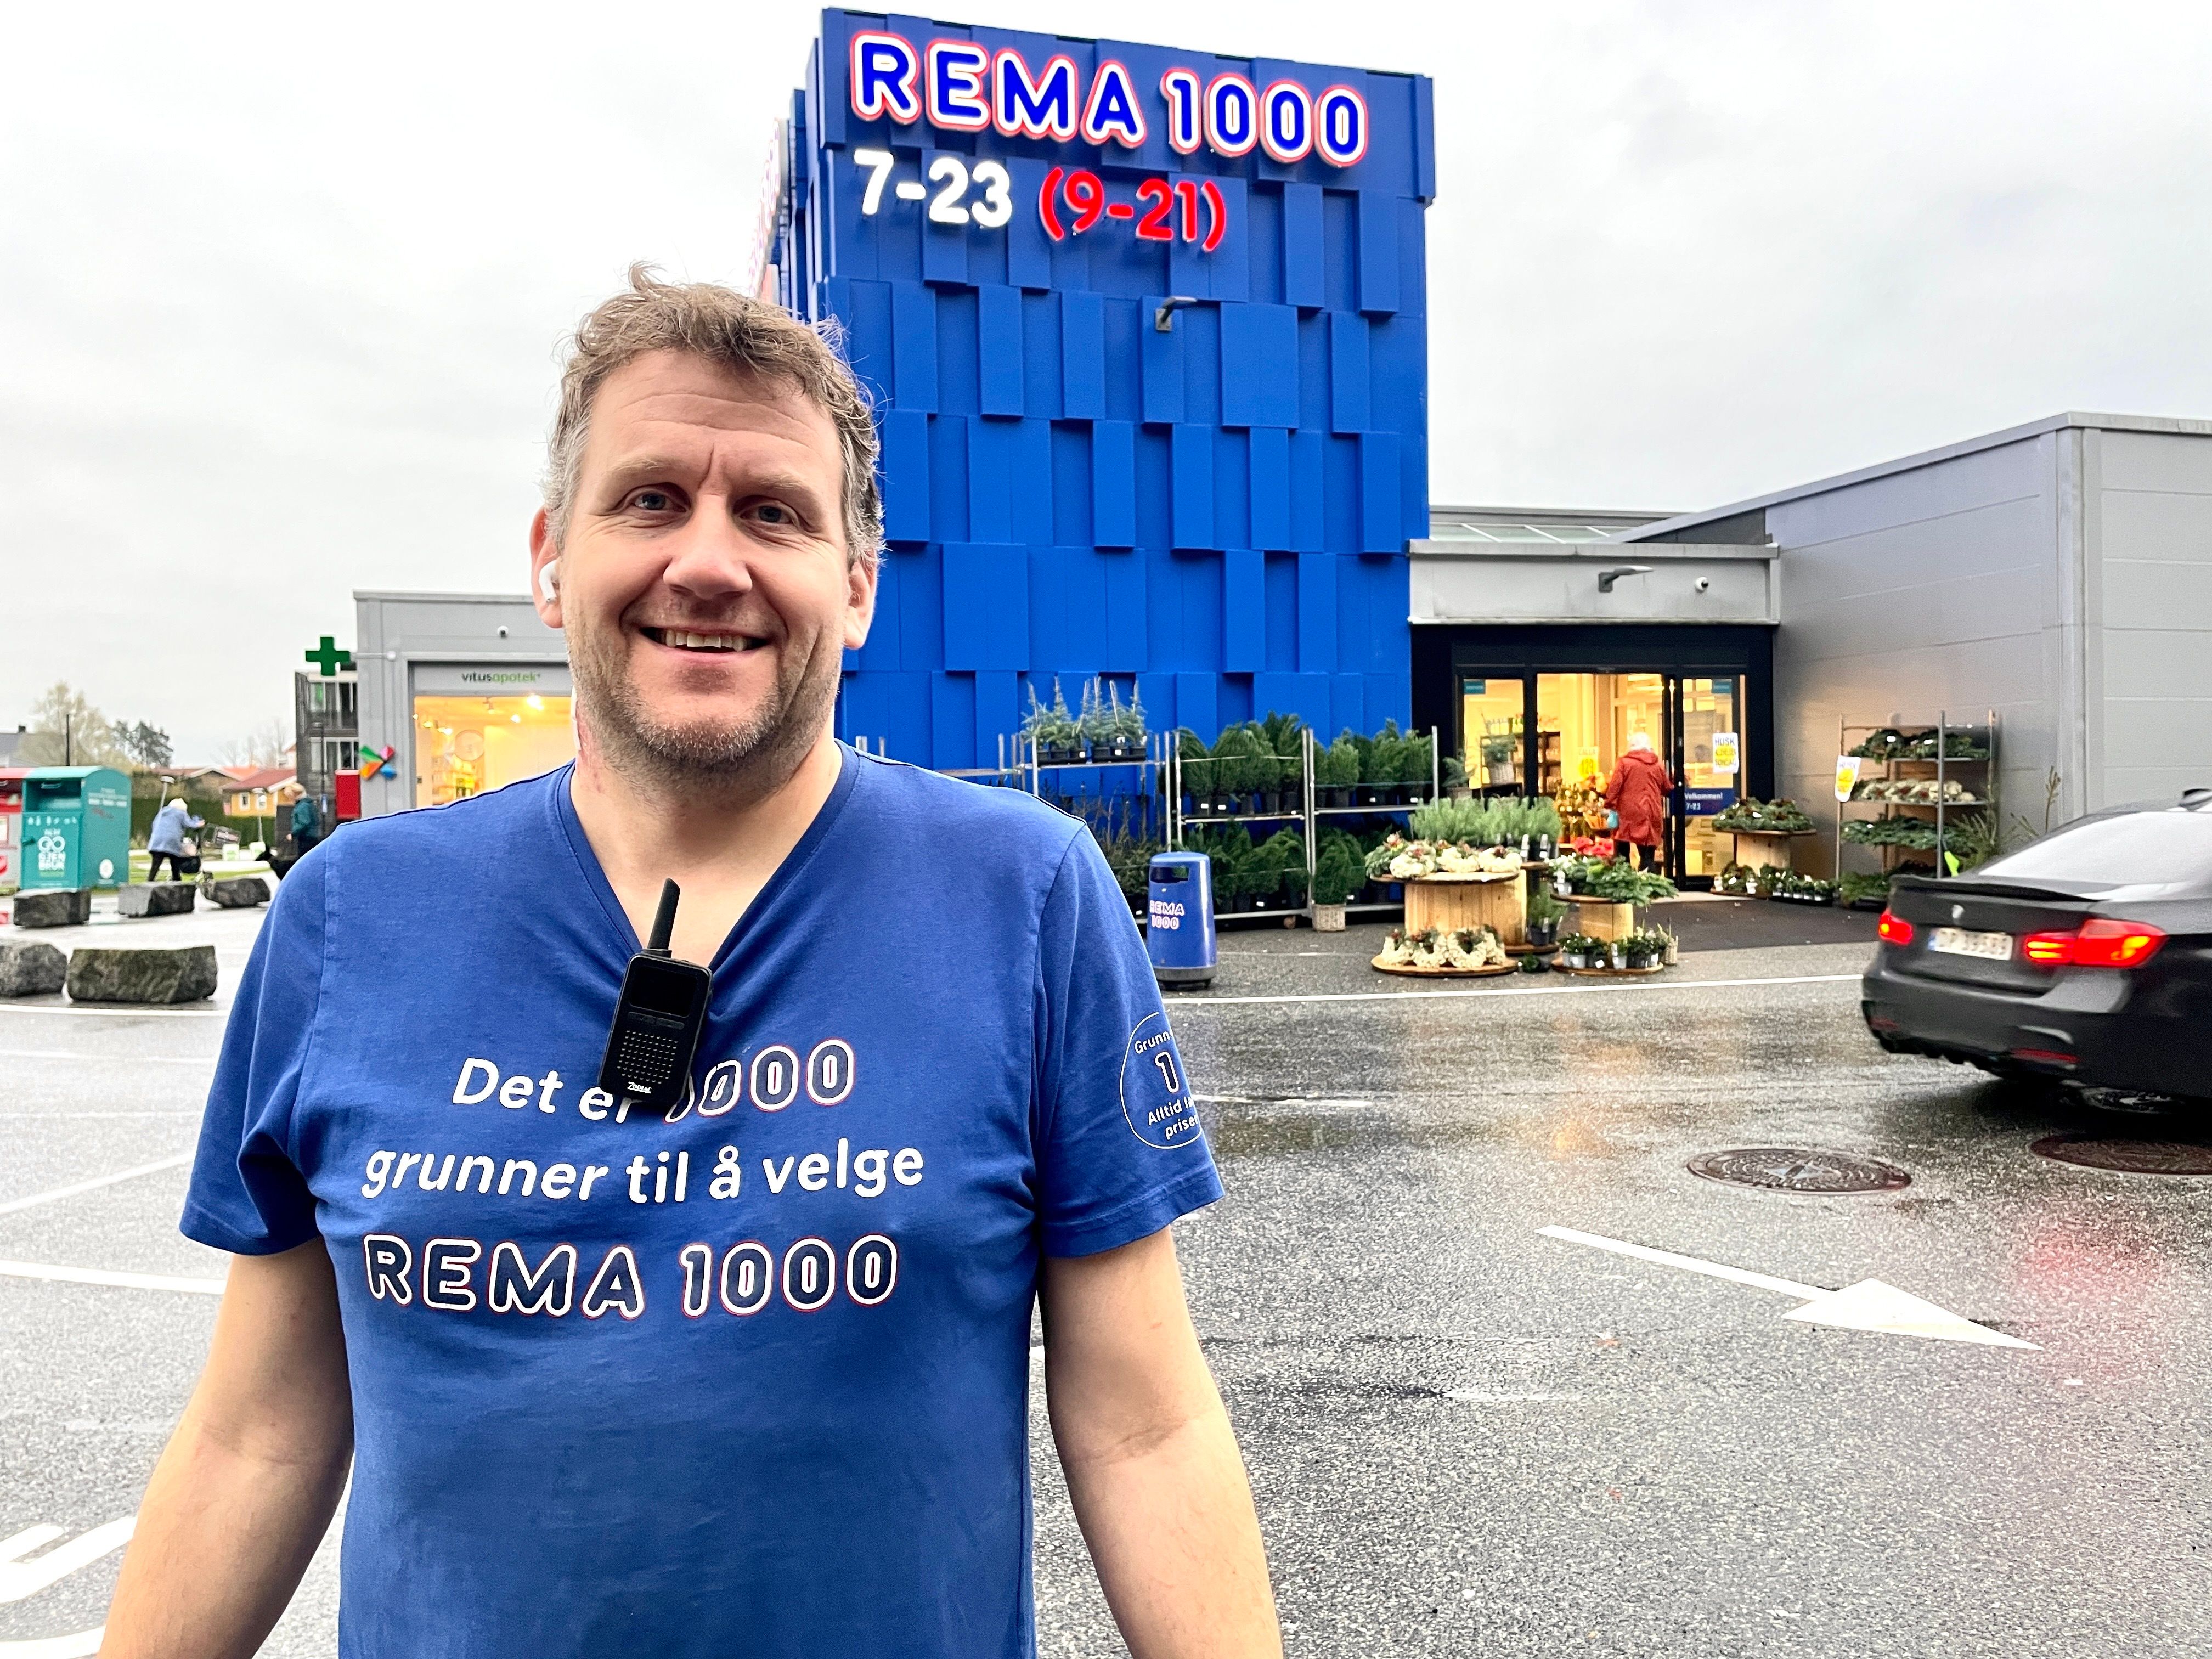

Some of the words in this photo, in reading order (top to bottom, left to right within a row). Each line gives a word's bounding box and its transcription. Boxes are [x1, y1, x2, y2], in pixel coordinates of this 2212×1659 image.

[850, 31, 1147, 148] REMA
[1161, 68, 1368, 168] 1000
[854, 149, 1012, 228] 7-23
[1039, 167, 1226, 251] (9-21)
[1715, 737, 1735, 746] HUSK
[1684, 792, 1723, 800] Velkommen!
[1150, 900, 1184, 916] REMA
[1152, 915, 1180, 929] 1000
[452, 1057, 563, 1114] Det
[1154, 1051, 1179, 1093] 1
[1148, 1099, 1182, 1125] Alltid
[361, 1150, 609, 1200] grunner
[625, 1150, 689, 1204] til
[709, 1145, 741, 1200] å
[763, 1138, 924, 1198] velge
[362, 1234, 646, 1319] REMA
[678, 1234, 899, 1318] 1000
